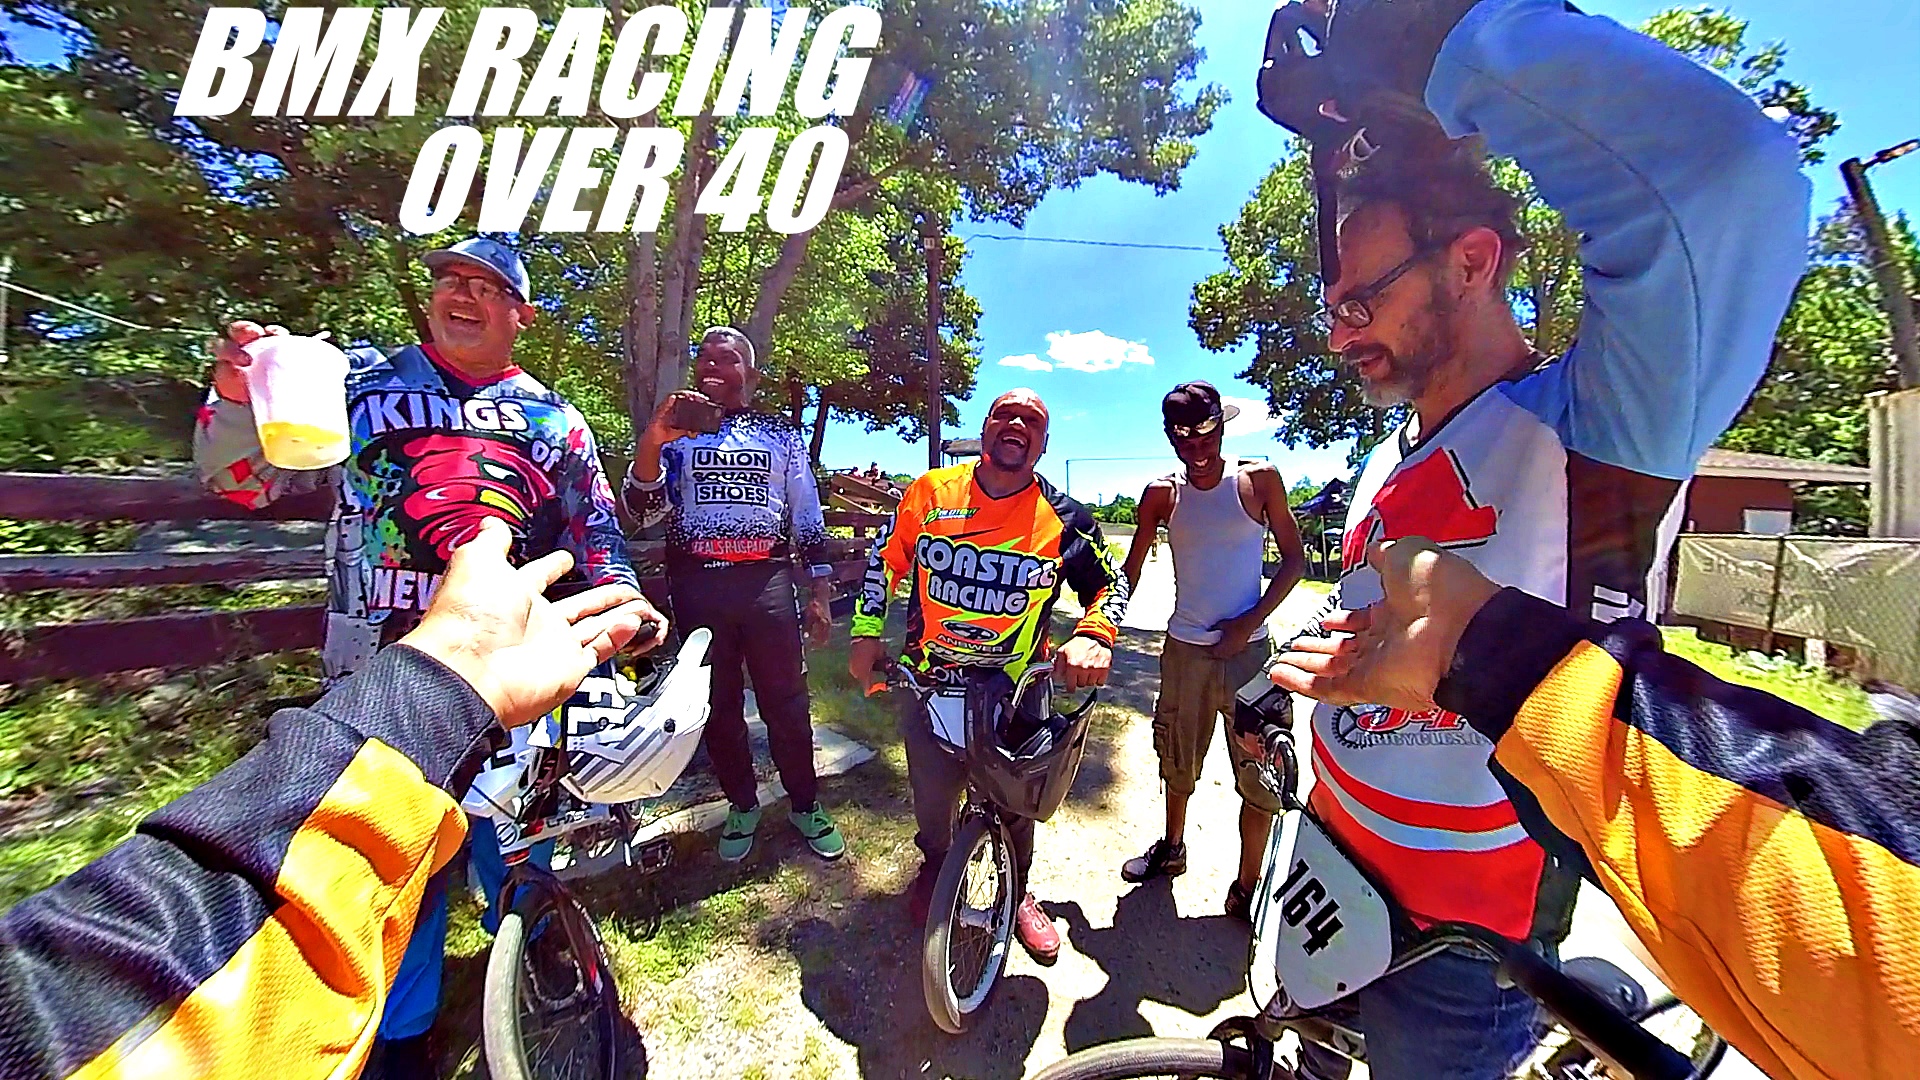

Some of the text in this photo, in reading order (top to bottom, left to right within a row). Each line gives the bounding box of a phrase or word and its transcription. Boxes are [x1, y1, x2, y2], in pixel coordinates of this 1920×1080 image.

[364, 392, 530, 434] KINGS
[698, 450, 767, 468] UNION
[692, 471, 769, 484] SQUARE
[699, 485, 766, 502] SHOES
[917, 536, 1057, 588] COASTAL
[930, 577, 1028, 613] RACING
[937, 634, 1003, 653] ANSWER
[1272, 859, 1344, 957] 164
